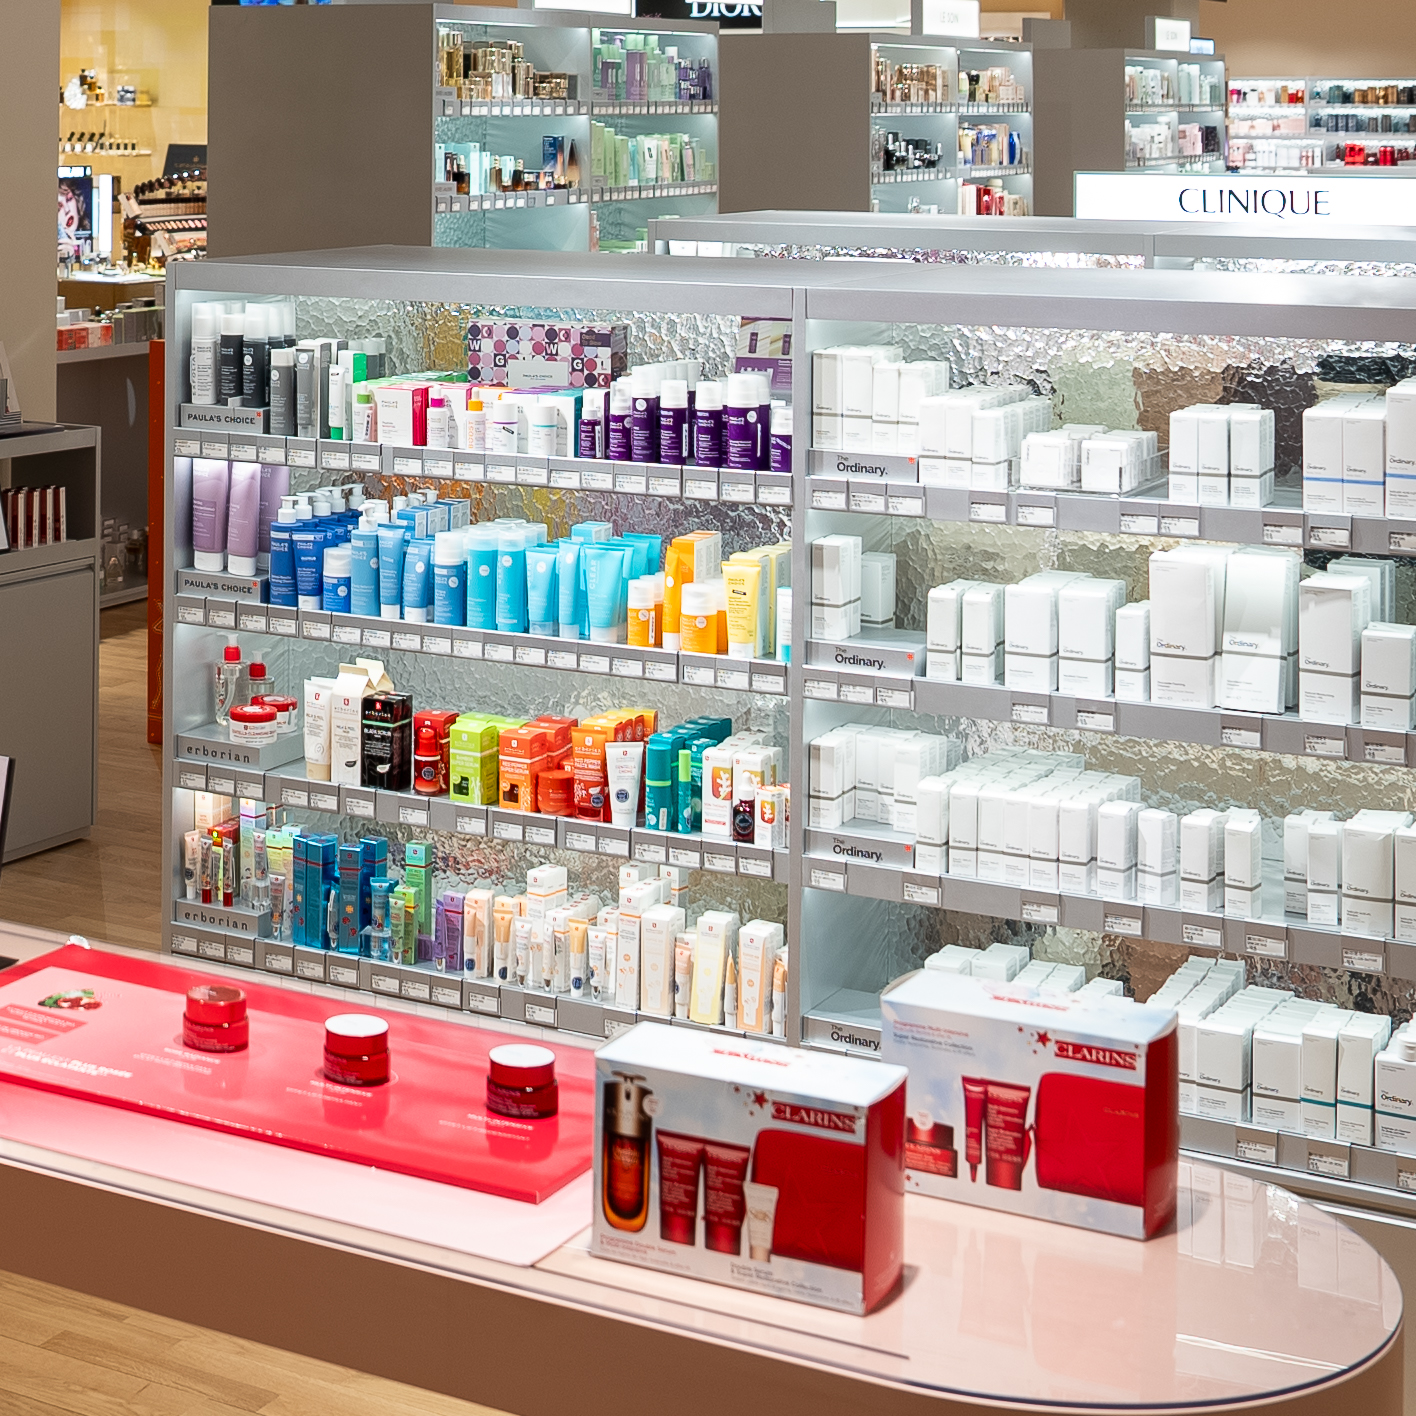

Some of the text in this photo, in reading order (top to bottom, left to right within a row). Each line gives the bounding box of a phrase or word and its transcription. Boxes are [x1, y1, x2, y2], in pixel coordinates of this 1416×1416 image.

[1179, 188, 1331, 219] CLINIQUE
[469, 340, 480, 351] W
[546, 343, 558, 354] W
[187, 413, 255, 425] PAULA'S CHOICE
[184, 579, 253, 594] PAULA'S CHOICE
[186, 745, 250, 764] erborian
[833, 837, 845, 845] The
[184, 909, 248, 931] erborian
[830, 1023, 843, 1032] The
[1054, 1041, 1137, 1070] CLARINS
[772, 1102, 856, 1132] CLARINS
